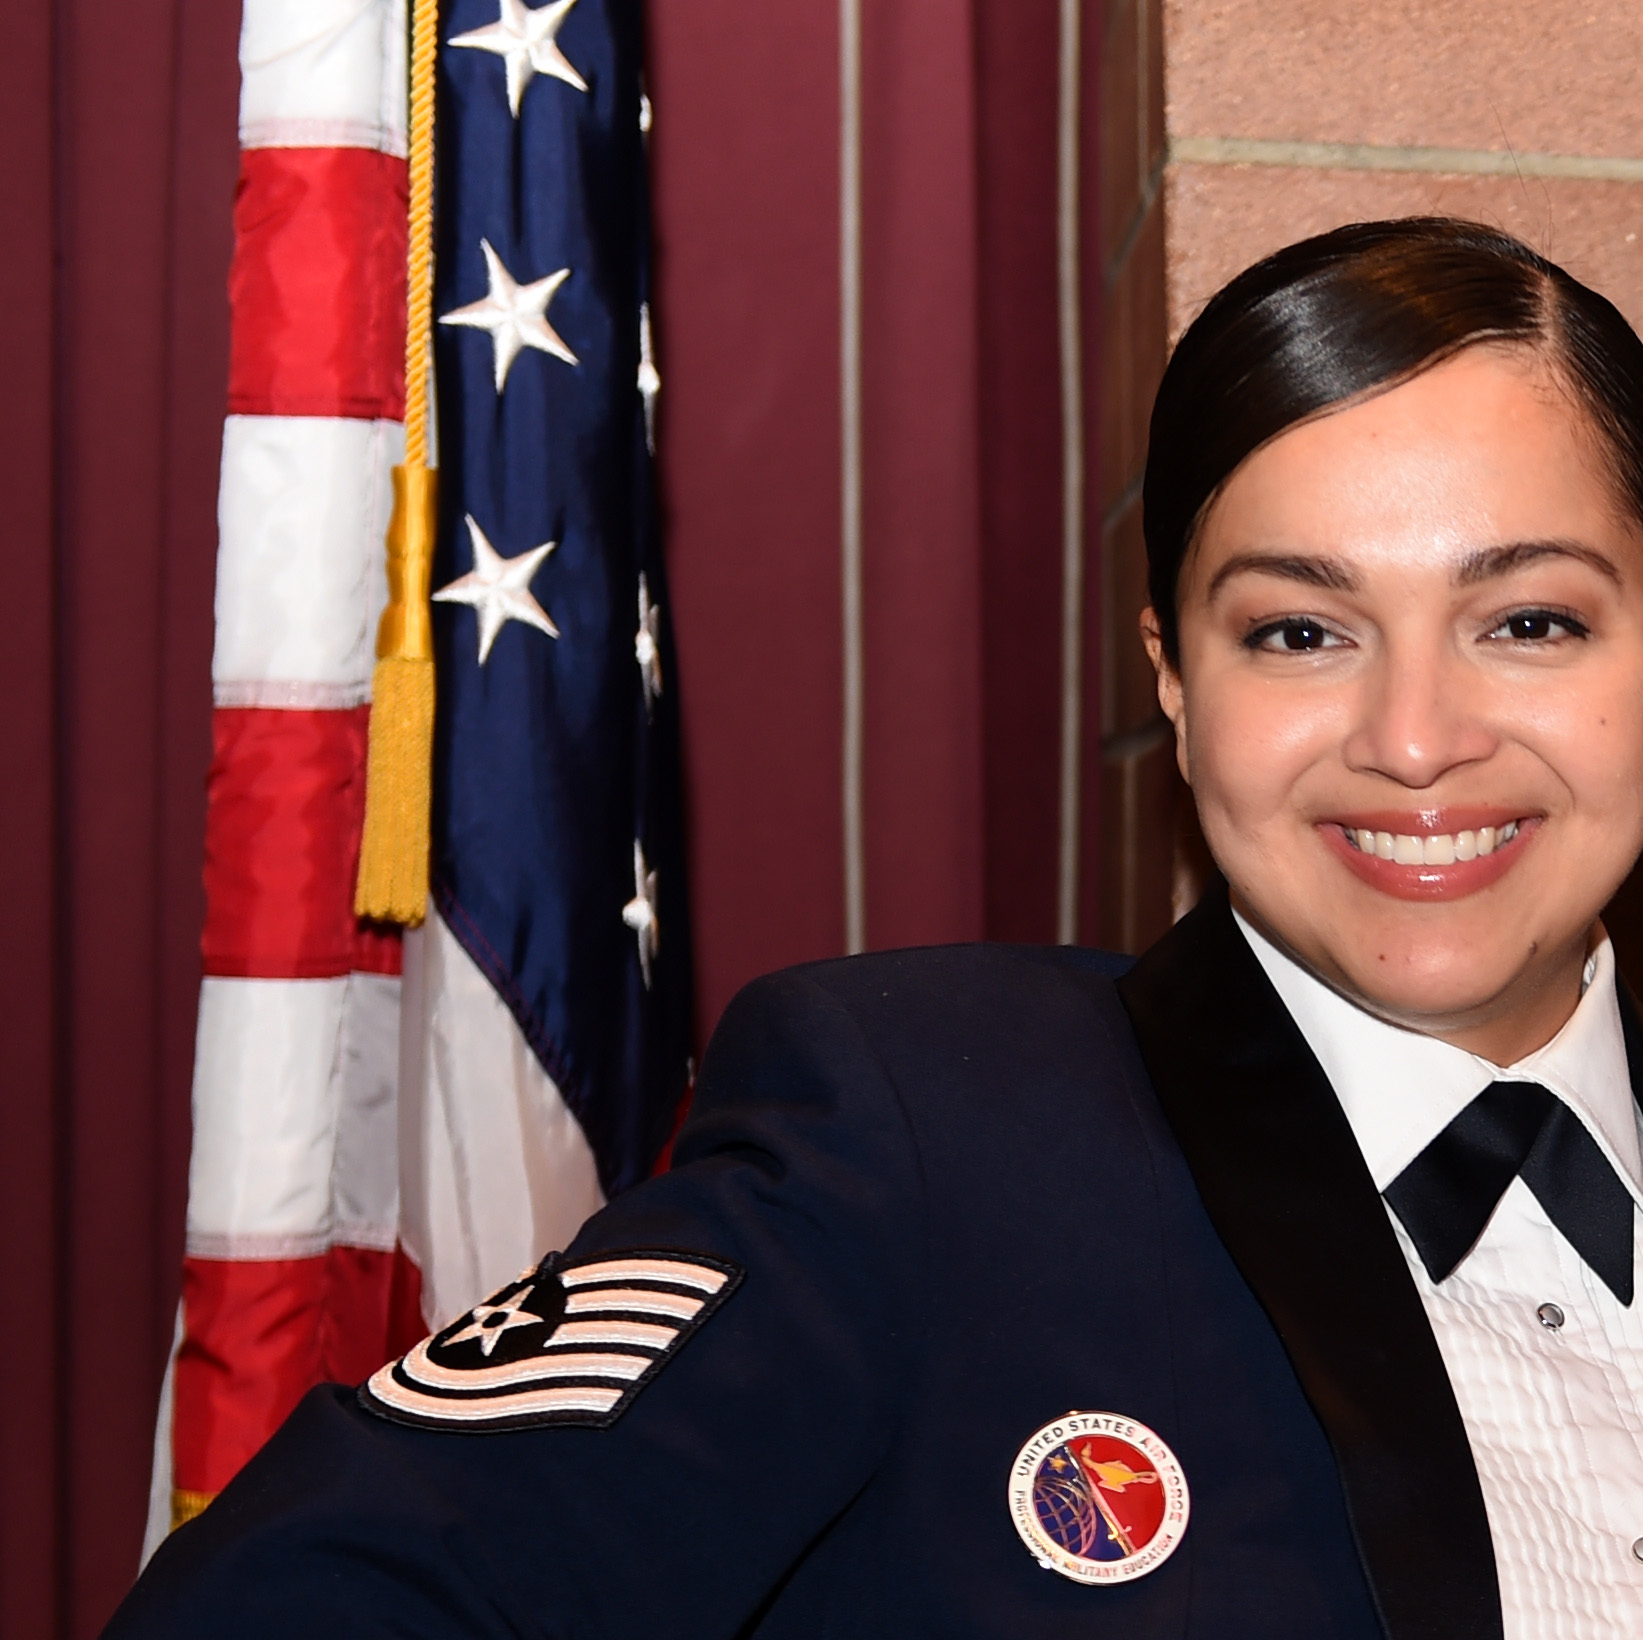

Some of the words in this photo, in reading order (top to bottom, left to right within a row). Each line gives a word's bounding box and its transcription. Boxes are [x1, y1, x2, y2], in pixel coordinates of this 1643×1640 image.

[1016, 1426, 1063, 1477] UNITED
[1067, 1417, 1134, 1438] STATES
[1138, 1436, 1167, 1463] AIR
[1167, 1465, 1184, 1523] FORCE
[1062, 1560, 1119, 1578] MILITARY
[1123, 1533, 1174, 1574] EDUCATION
